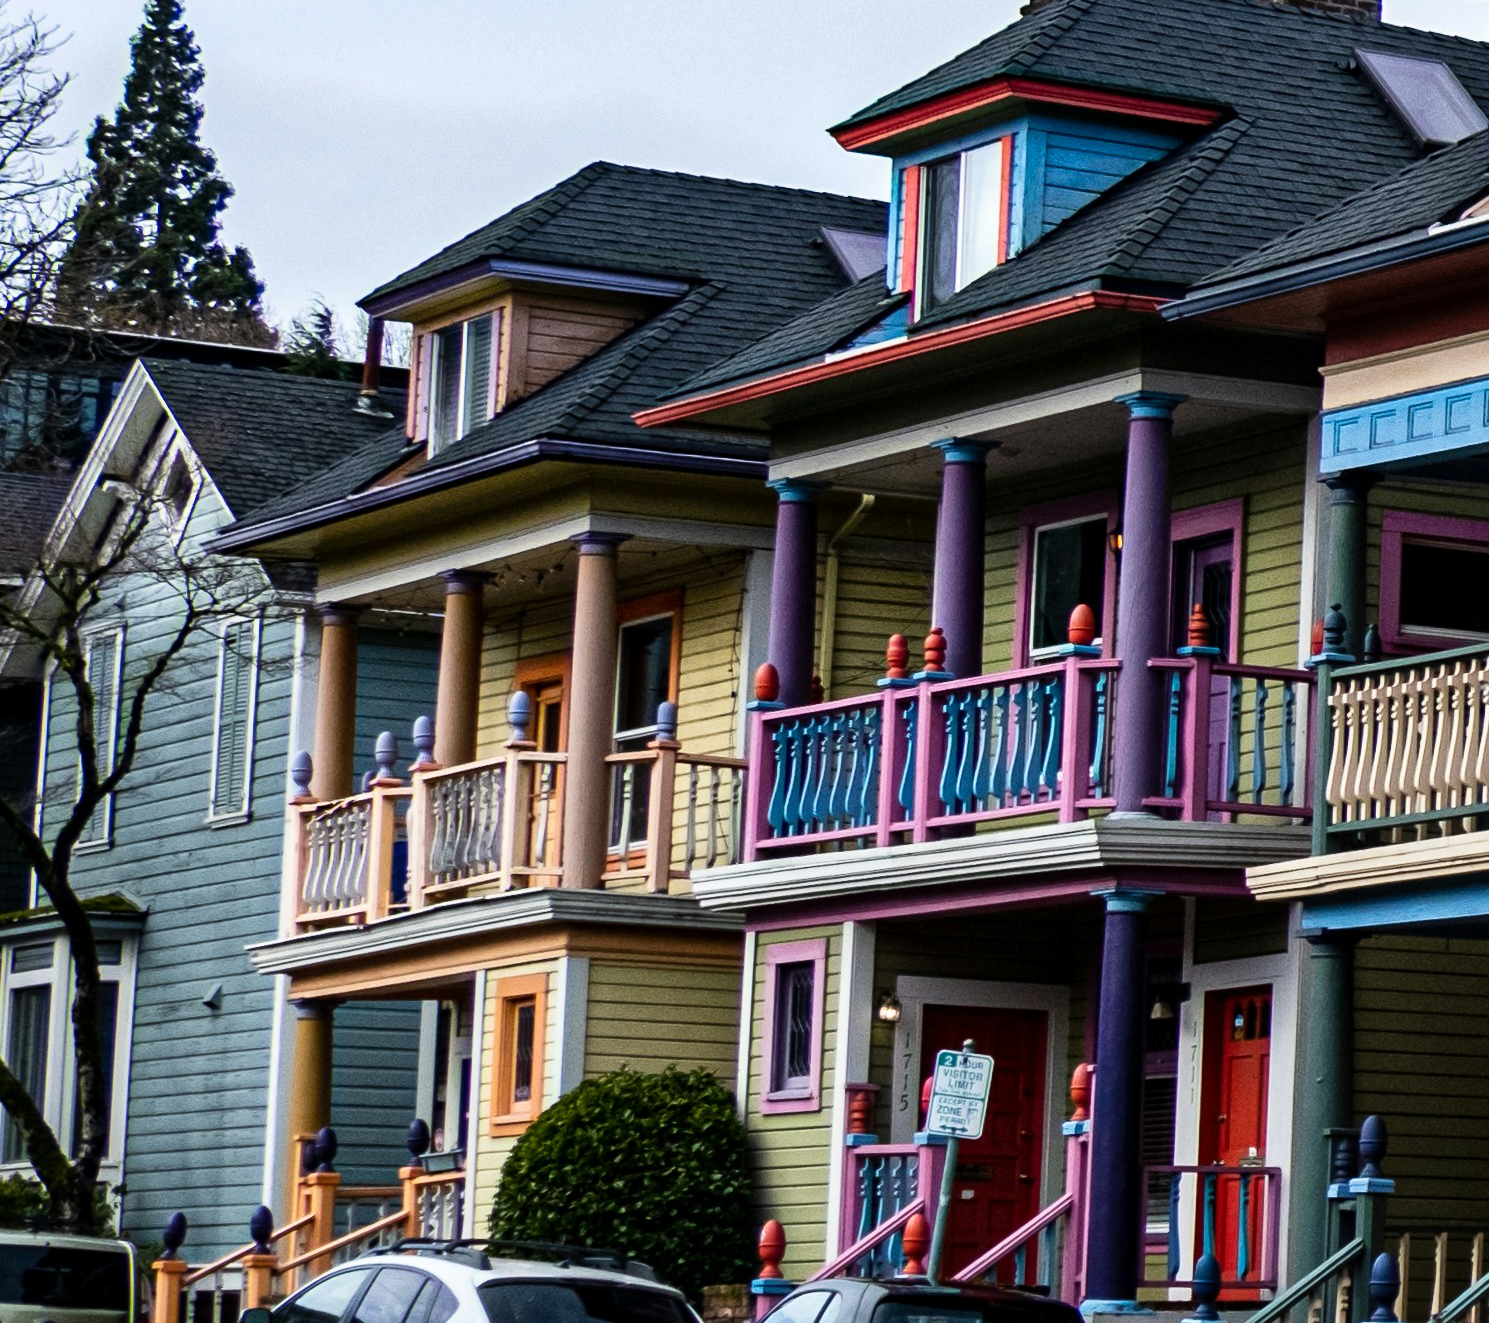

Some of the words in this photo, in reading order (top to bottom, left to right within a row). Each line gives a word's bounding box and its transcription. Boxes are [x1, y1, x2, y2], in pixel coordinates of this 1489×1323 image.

[943, 1055, 953, 1066] 2
[899, 1031, 913, 1112] 1715
[943, 1068, 983, 1082] VISITOR
[948, 1079, 975, 1091] LIMIT
[937, 1104, 963, 1117] ZONE
